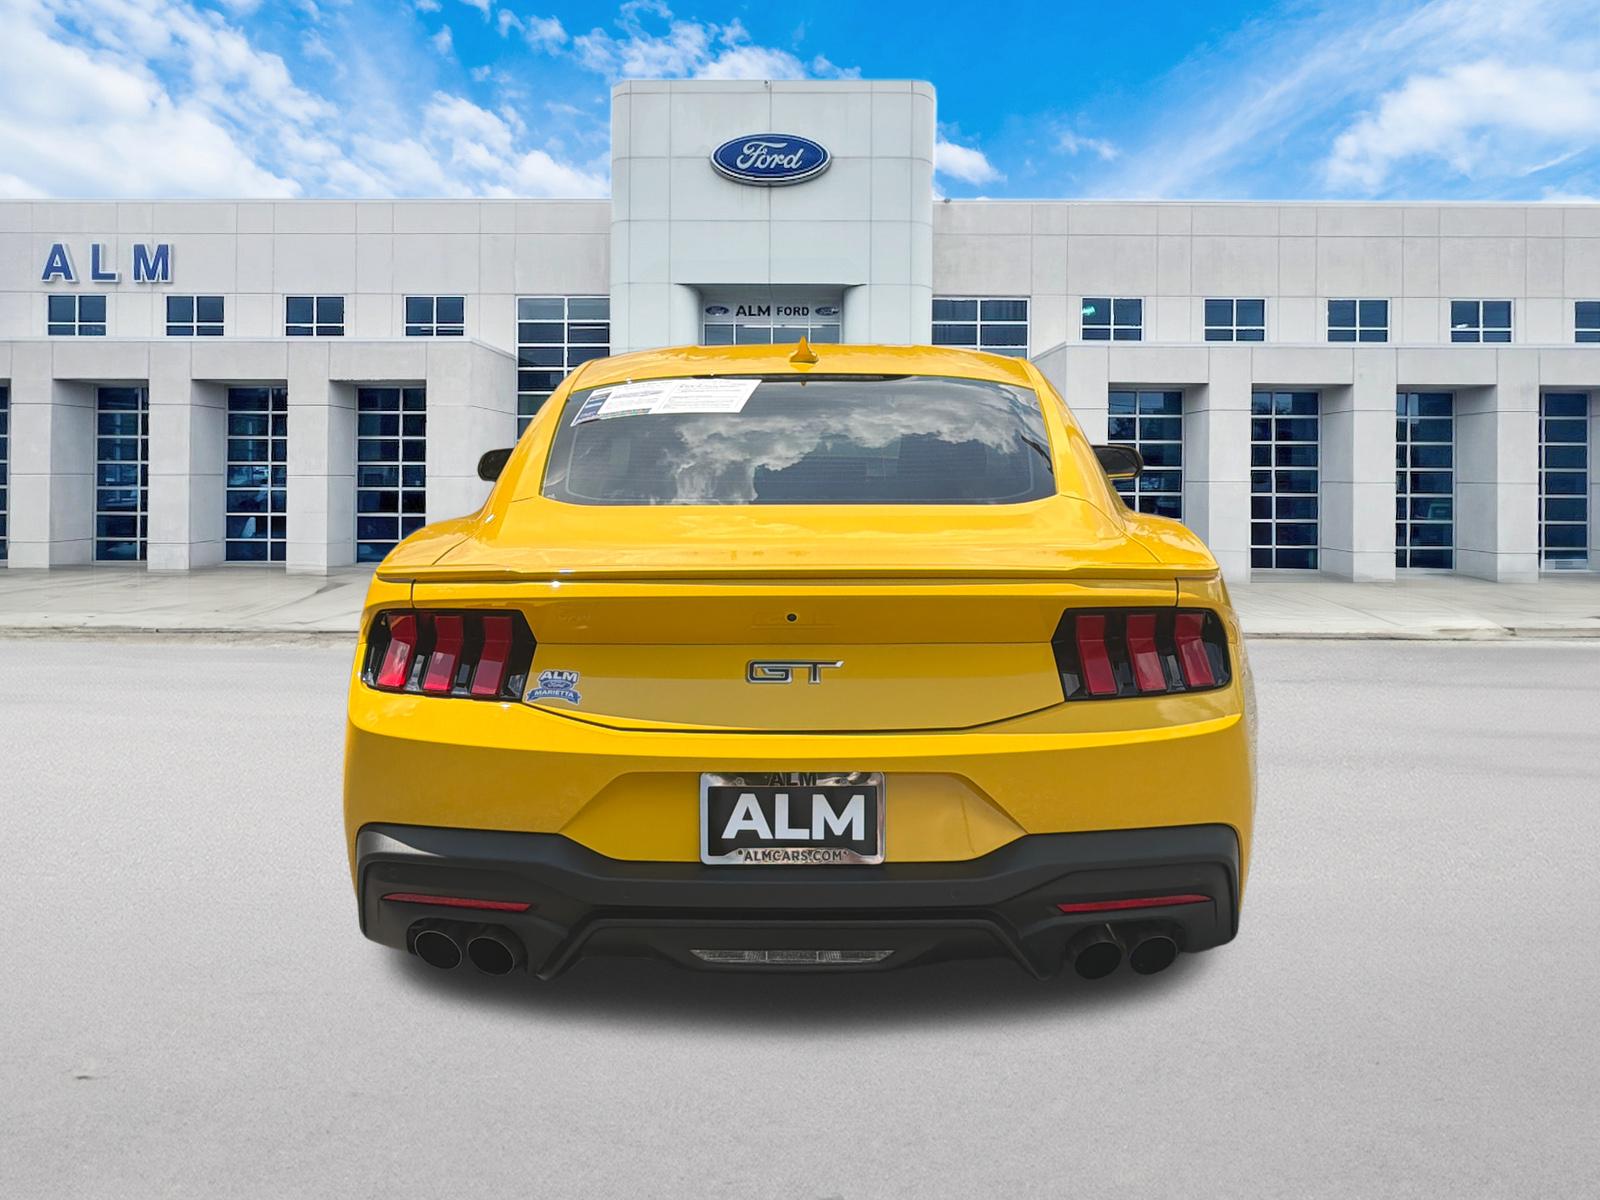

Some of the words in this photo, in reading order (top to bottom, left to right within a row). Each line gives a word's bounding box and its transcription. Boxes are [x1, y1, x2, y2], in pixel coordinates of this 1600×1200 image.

[736, 141, 804, 170] Ford
[41, 243, 171, 282] ALM
[735, 305, 771, 317] ALM
[776, 306, 810, 317] FORD
[540, 671, 578, 682] ALM
[747, 660, 844, 684] GT
[534, 689, 575, 698] MARIETTA
[768, 772, 817, 786] ALM
[721, 793, 865, 841] ALM
[744, 850, 842, 861] ALMCARS.COM
